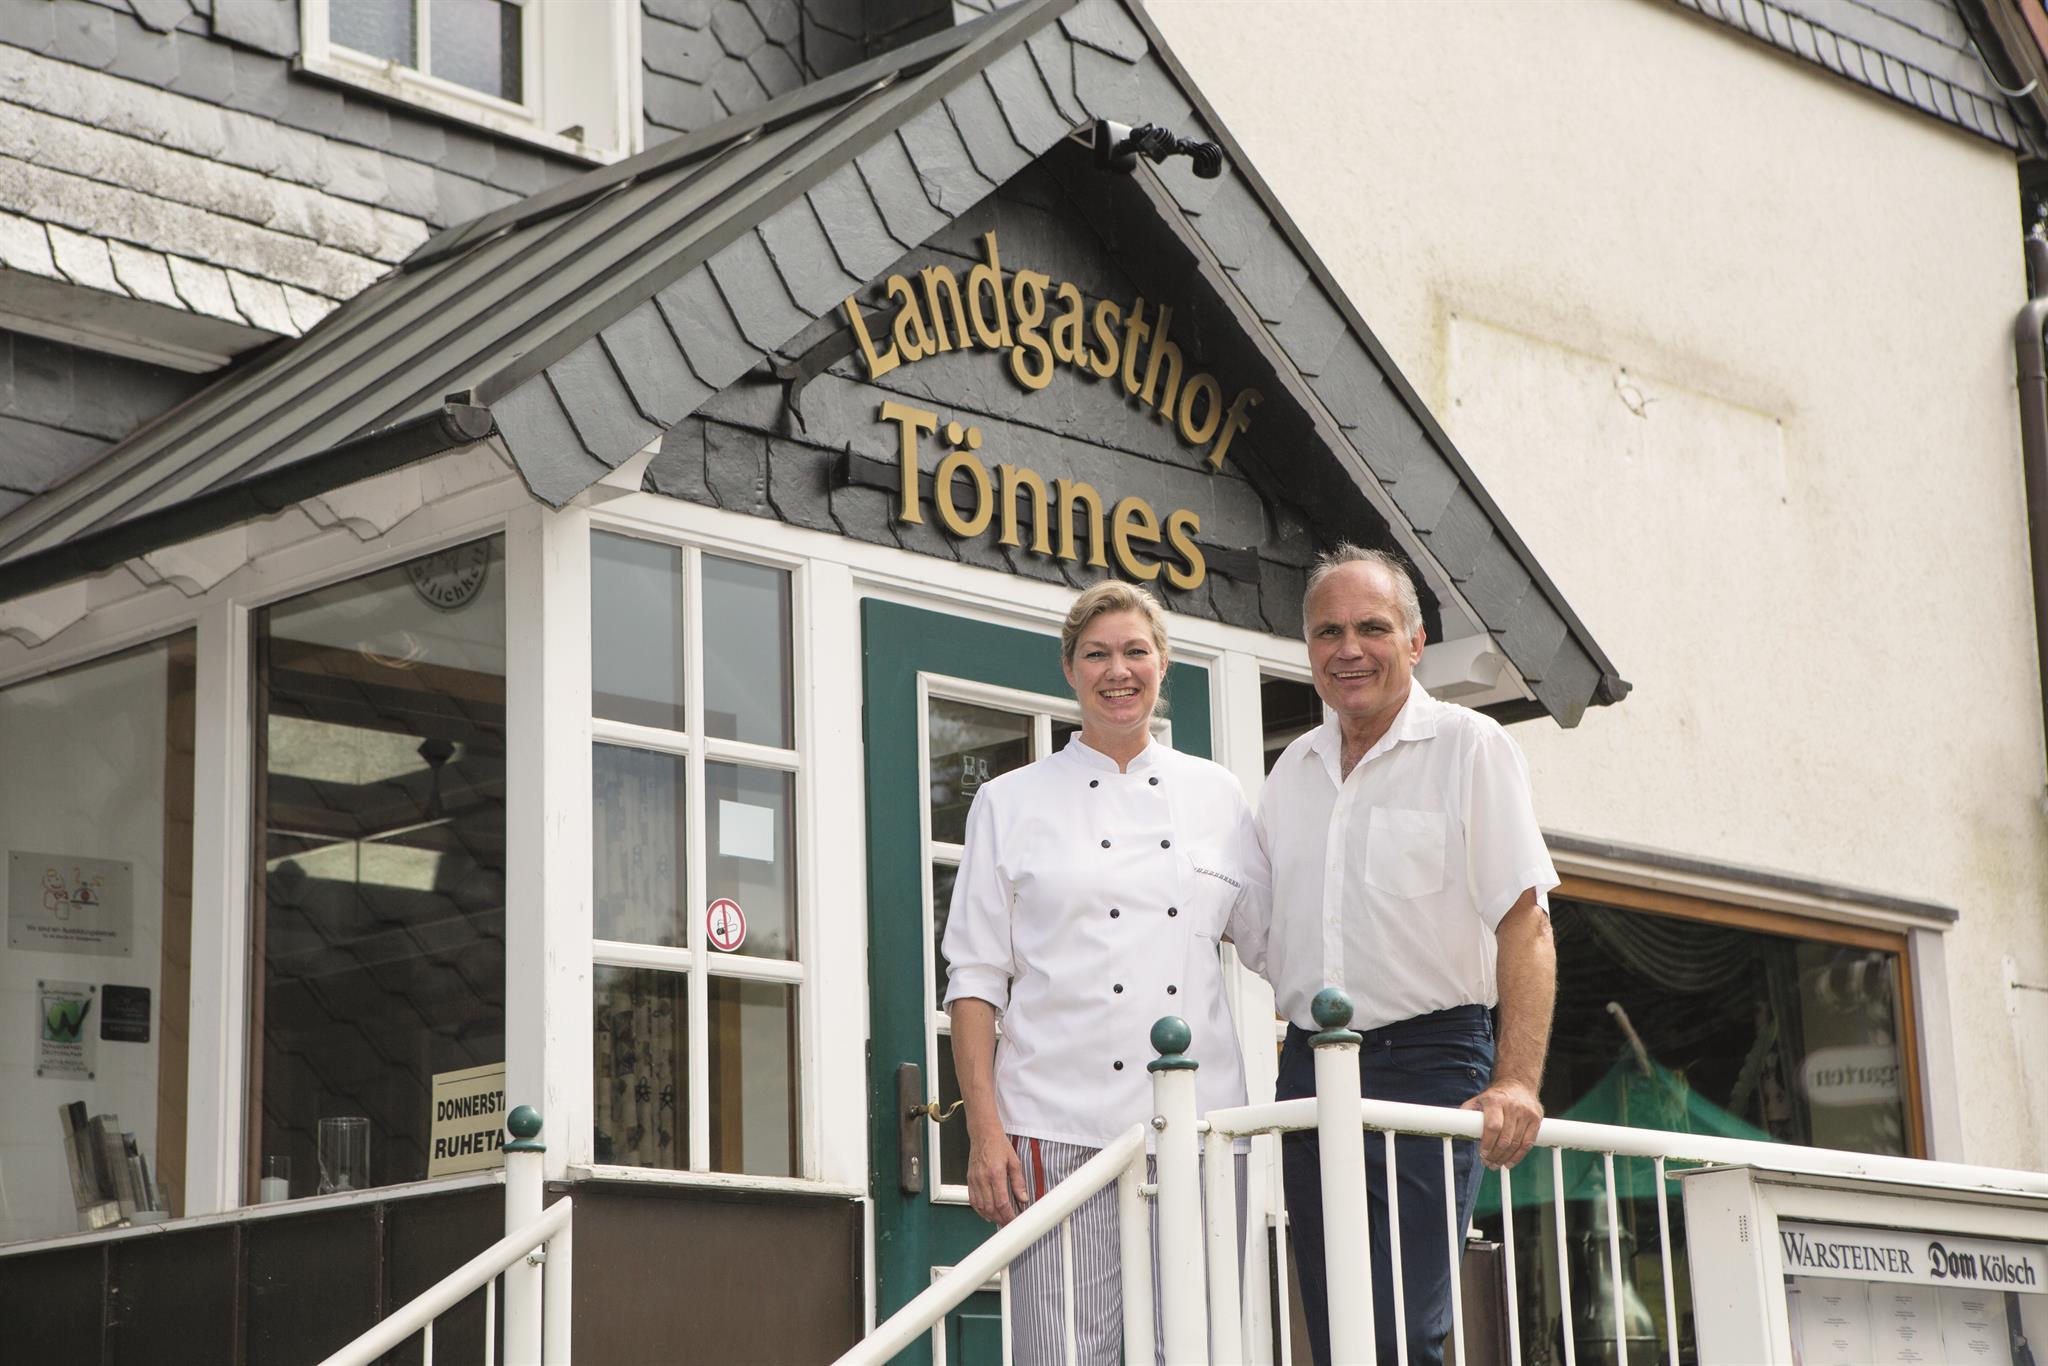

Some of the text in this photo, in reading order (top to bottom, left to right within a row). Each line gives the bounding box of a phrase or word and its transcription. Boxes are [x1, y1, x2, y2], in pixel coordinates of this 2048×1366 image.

[844, 230, 1264, 471] Landgasthof
[880, 400, 1206, 590] Tönnes
[437, 1090, 505, 1122] DONNERST
[1780, 1232, 1914, 1274] WARSTEINER
[1928, 1241, 2036, 1286] Dom Kölsch
